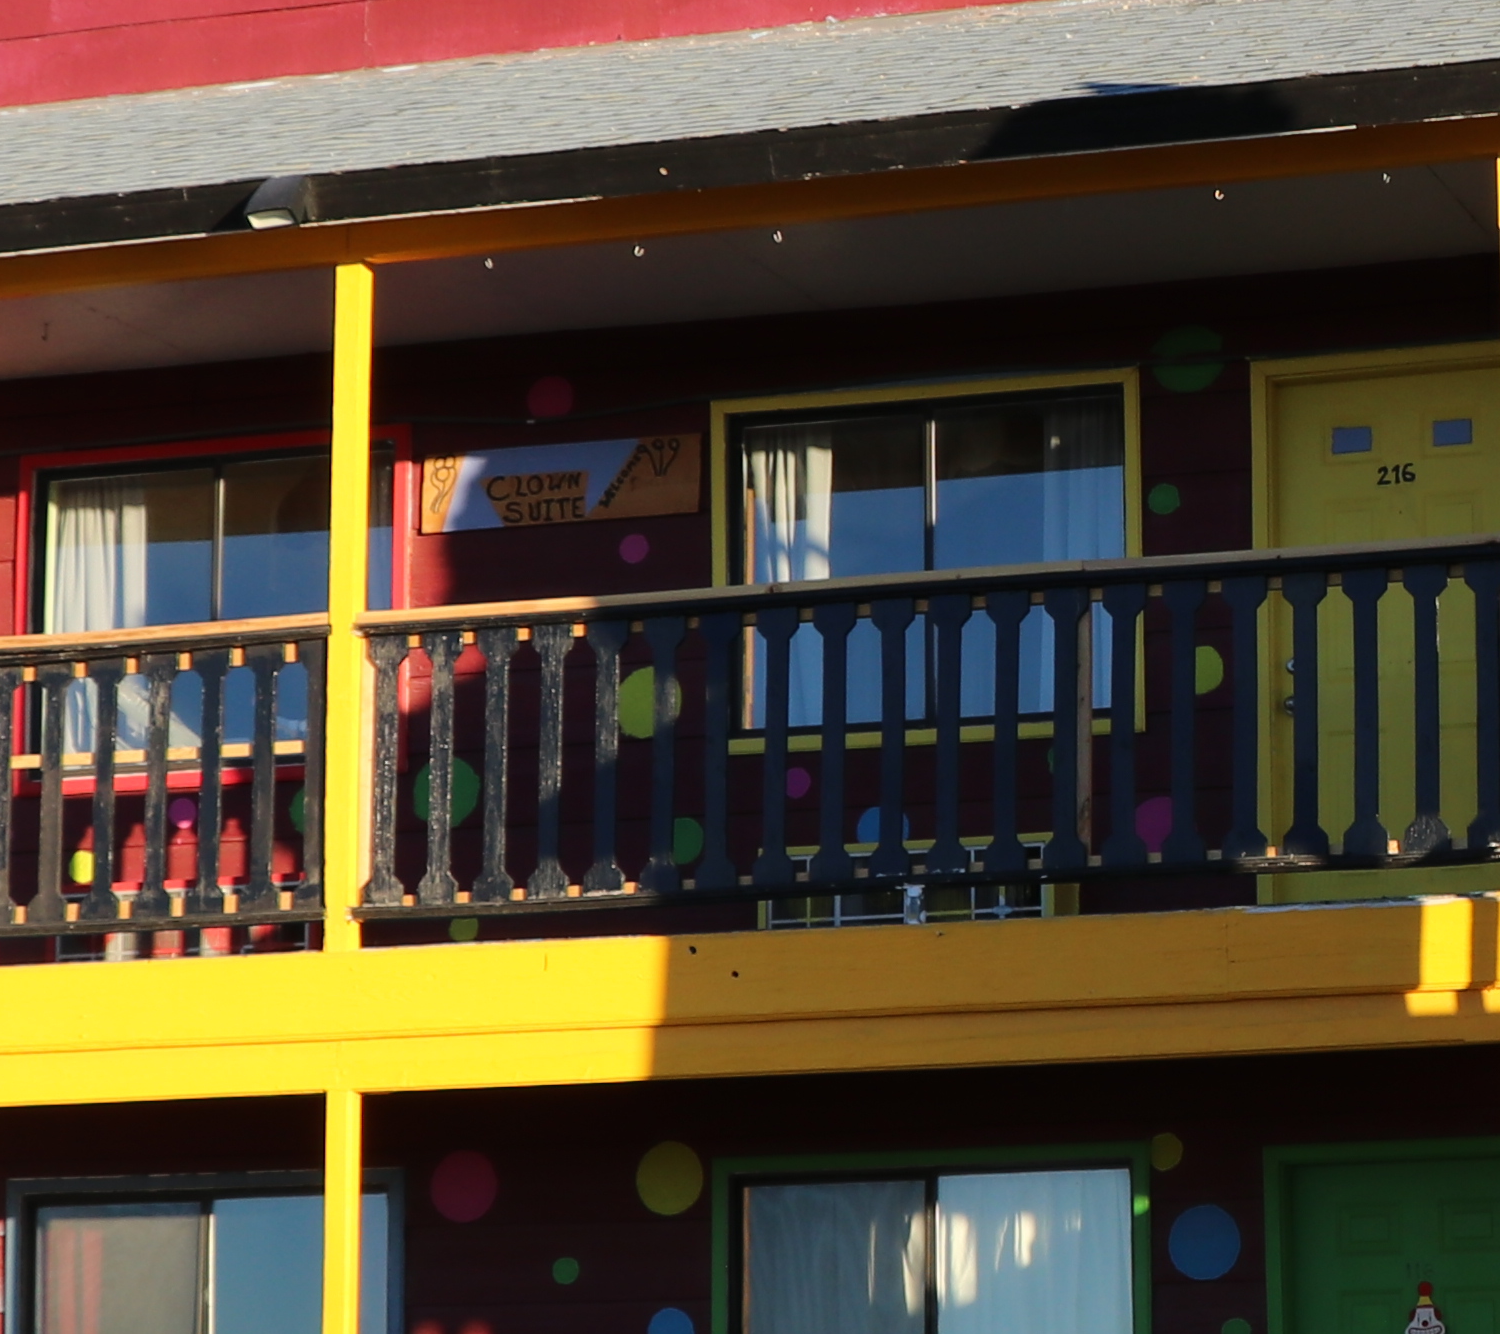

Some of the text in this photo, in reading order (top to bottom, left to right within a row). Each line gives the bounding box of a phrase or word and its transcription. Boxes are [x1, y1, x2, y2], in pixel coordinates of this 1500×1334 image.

[486, 471, 582, 501] CLOWN
[1377, 462, 1416, 485] 216
[503, 496, 586, 524] SUITE
